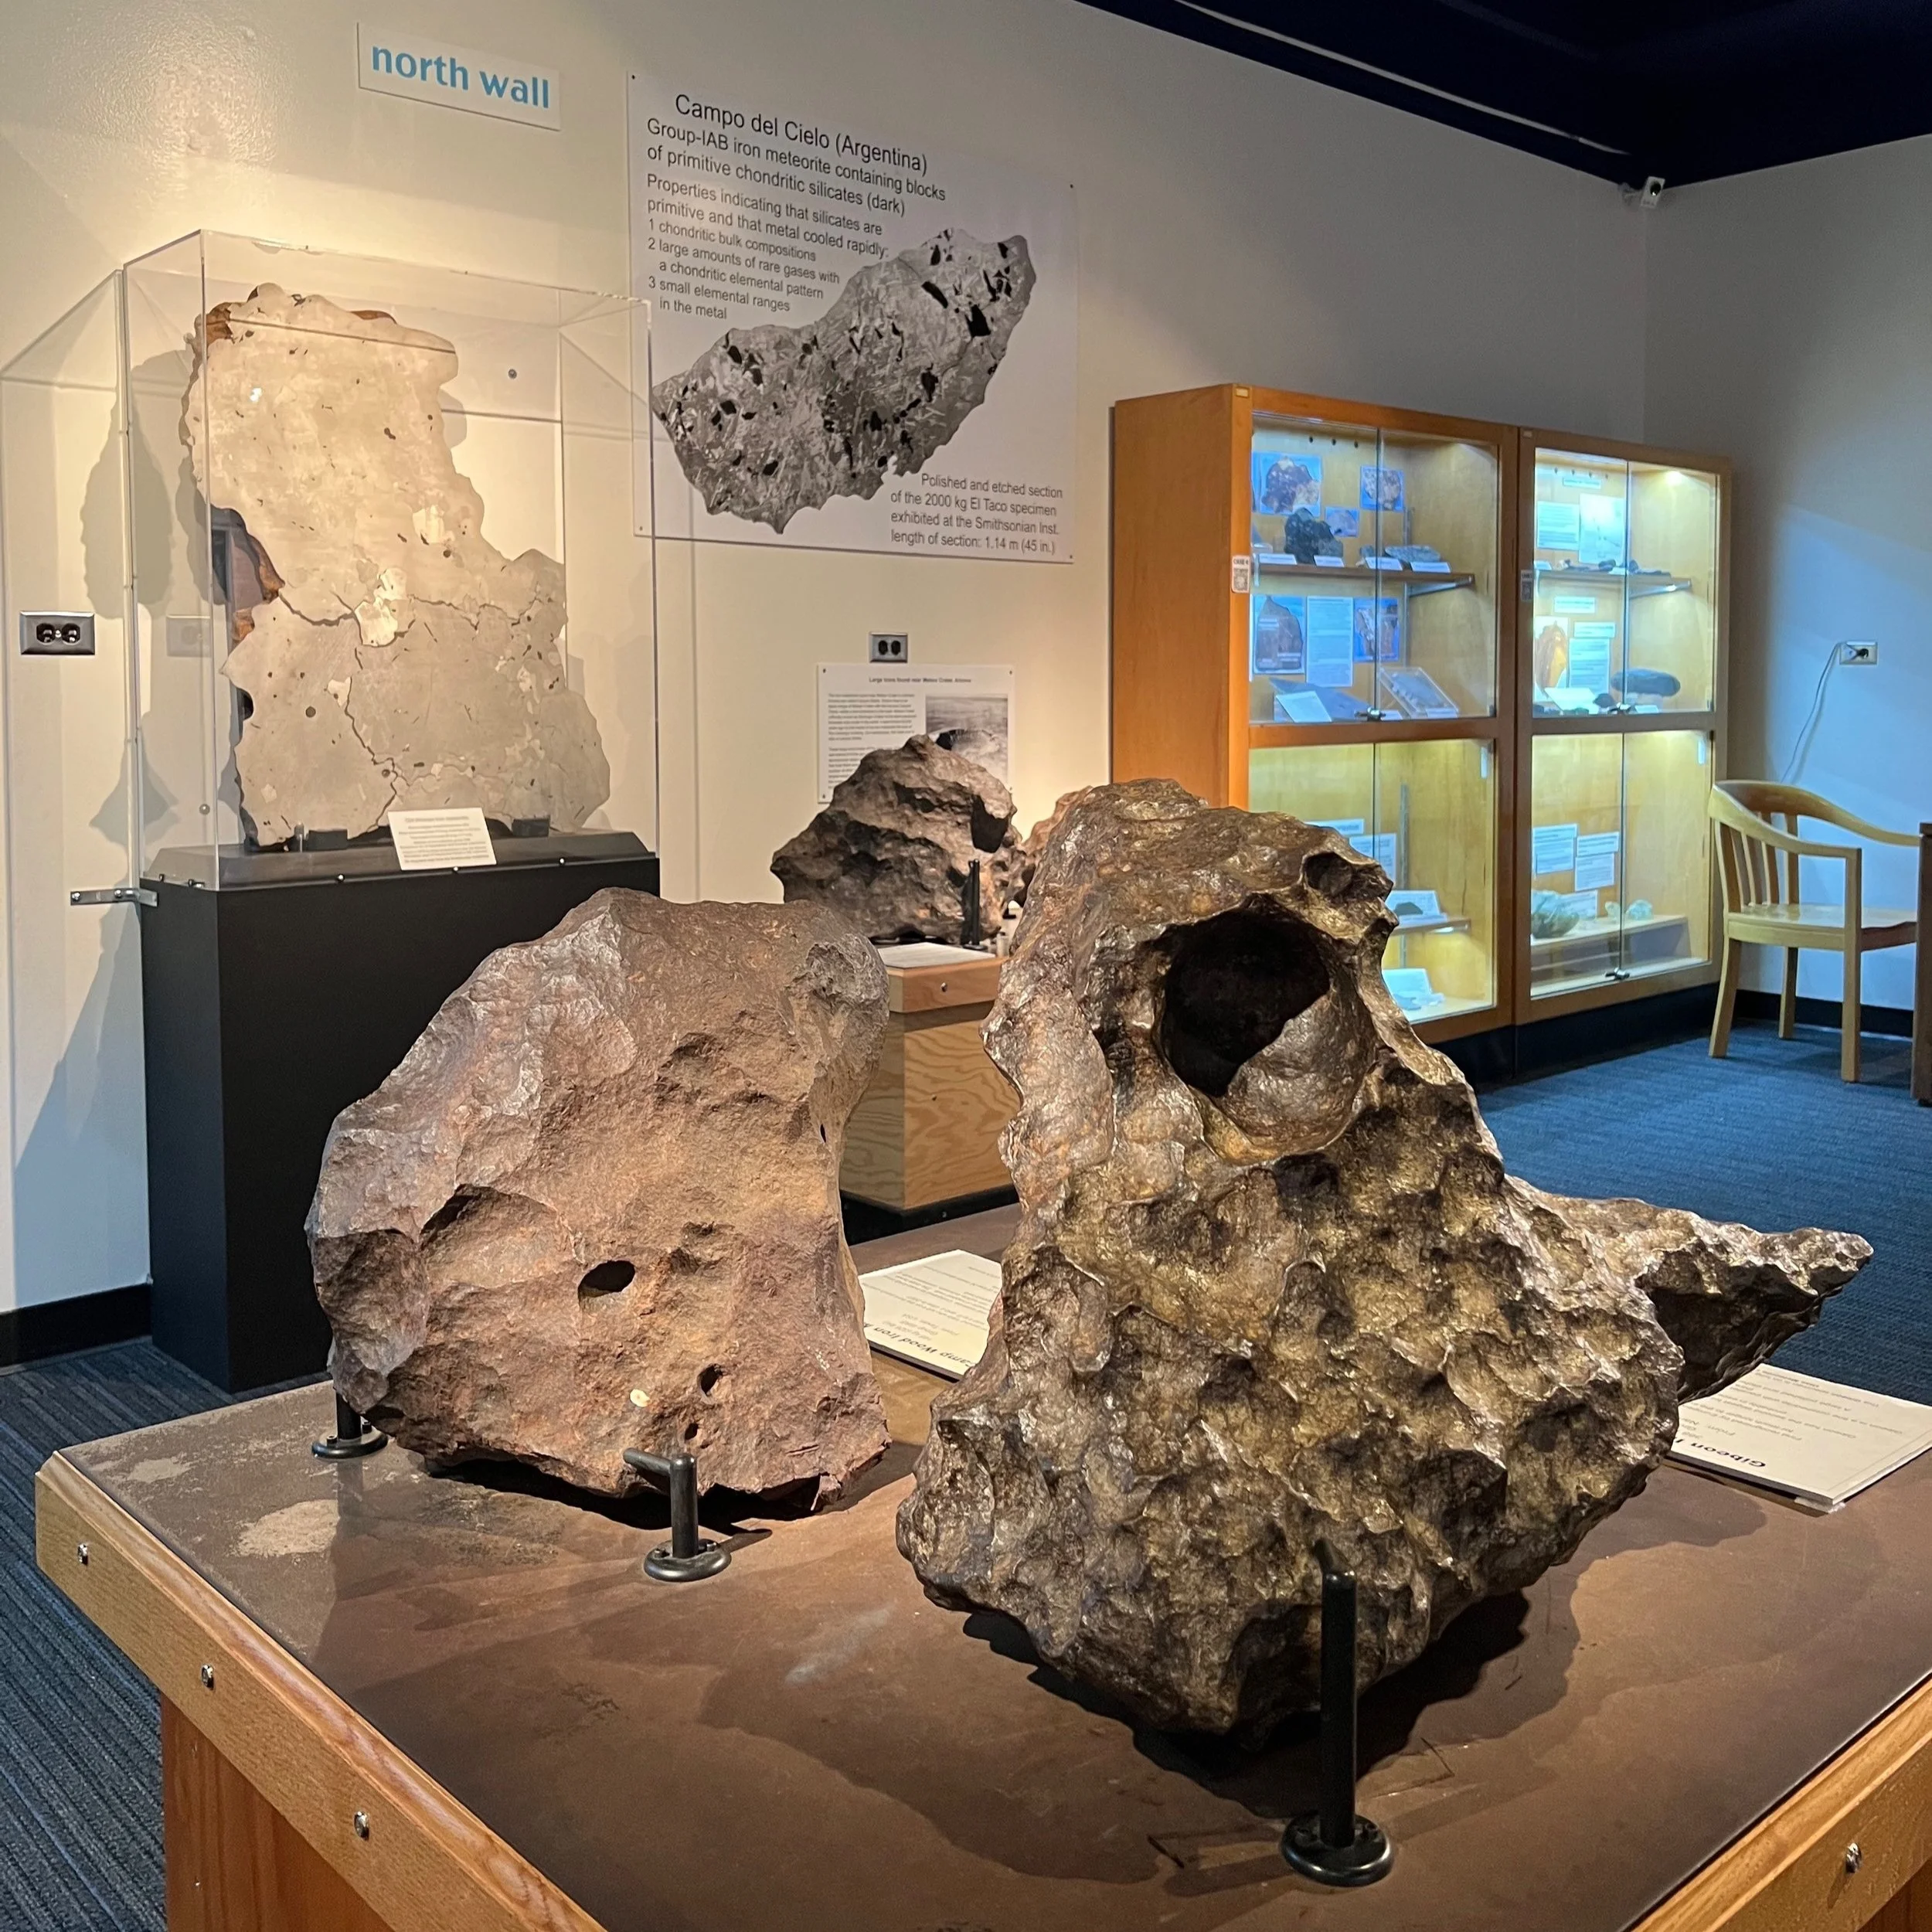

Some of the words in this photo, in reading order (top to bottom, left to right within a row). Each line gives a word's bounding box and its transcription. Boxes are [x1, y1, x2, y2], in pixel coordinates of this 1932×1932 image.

[372, 46, 469, 90] north
[479, 70, 549, 108] wall
[675, 94, 745, 130] Campo
[750, 113, 779, 138] del
[785, 121, 832, 148] Cielo
[836, 133, 927, 178] (Argentina)
[648, 117, 730, 150] Group-IAB
[734, 137, 760, 159] iron
[764, 148, 832, 175] meteorite
[835, 165, 903, 195] containing
[904, 175, 946, 201] blocks
[648, 144, 663, 162] of
[668, 150, 731, 176] primitive
[736, 164, 806, 192] chondritic
[808, 180, 863, 205] silicates
[866, 192, 904, 218] (dark)
[648, 173, 717, 201] Properties
[721, 188, 782, 218] indicating
[785, 203, 808, 221] that
[812, 210, 860, 231] silicates
[863, 223, 883, 235] are
[648, 198, 704, 221] primitive
[709, 212, 733, 226] and
[737, 214, 762, 233] that
[766, 223, 800, 240] metal
[804, 230, 843, 249] cooled
[649, 218, 654, 230] 1
[659, 219, 716, 242] chondritic
[719, 230, 743, 247] bulk
[745, 240, 816, 261] compositions
[648, 236, 656, 250] 2
[659, 238, 689, 258] large
[692, 248, 742, 266] amounts
[745, 257, 756, 269] of
[759, 260, 781, 273] rare
[784, 265, 816, 280] gases
[819, 272, 839, 284] with
[648, 275, 656, 289] 3
[658, 281, 690, 295] small
[694, 284, 750, 304] elemental
[753, 297, 790, 312] ranges
[658, 261, 667, 272] a
[670, 260, 726, 282] chondritic
[730, 272, 783, 292] elemental
[787, 284, 824, 299] pattern
[660, 296, 670, 311] in
[674, 299, 692, 314] the
[696, 306, 726, 319] metal
[890, 490, 902, 503] of
[904, 492, 922, 505] the
[924, 492, 952, 508] 2000
[954, 495, 968, 511] kg
[971, 496, 981, 510] El
[983, 498, 1008, 513] Taco
[1010, 502, 1056, 516] specimen
[921, 473, 968, 490] Polished
[970, 479, 989, 492] and
[992, 482, 1026, 495] etched
[1028, 485, 1063, 498] section
[891, 511, 940, 526] exhibited
[943, 515, 954, 527] at
[956, 515, 972, 529] the
[975, 516, 1036, 533] Smithsonian
[891, 530, 925, 546] length
[927, 532, 939, 545] of
[1009, 541, 1019, 550] m
[1022, 538, 1037, 553] (45
[874, 1326, 900, 1339] Iron
[898, 1338, 938, 1353] Wood
[1690, 1442, 1766, 1467] Gibeon
